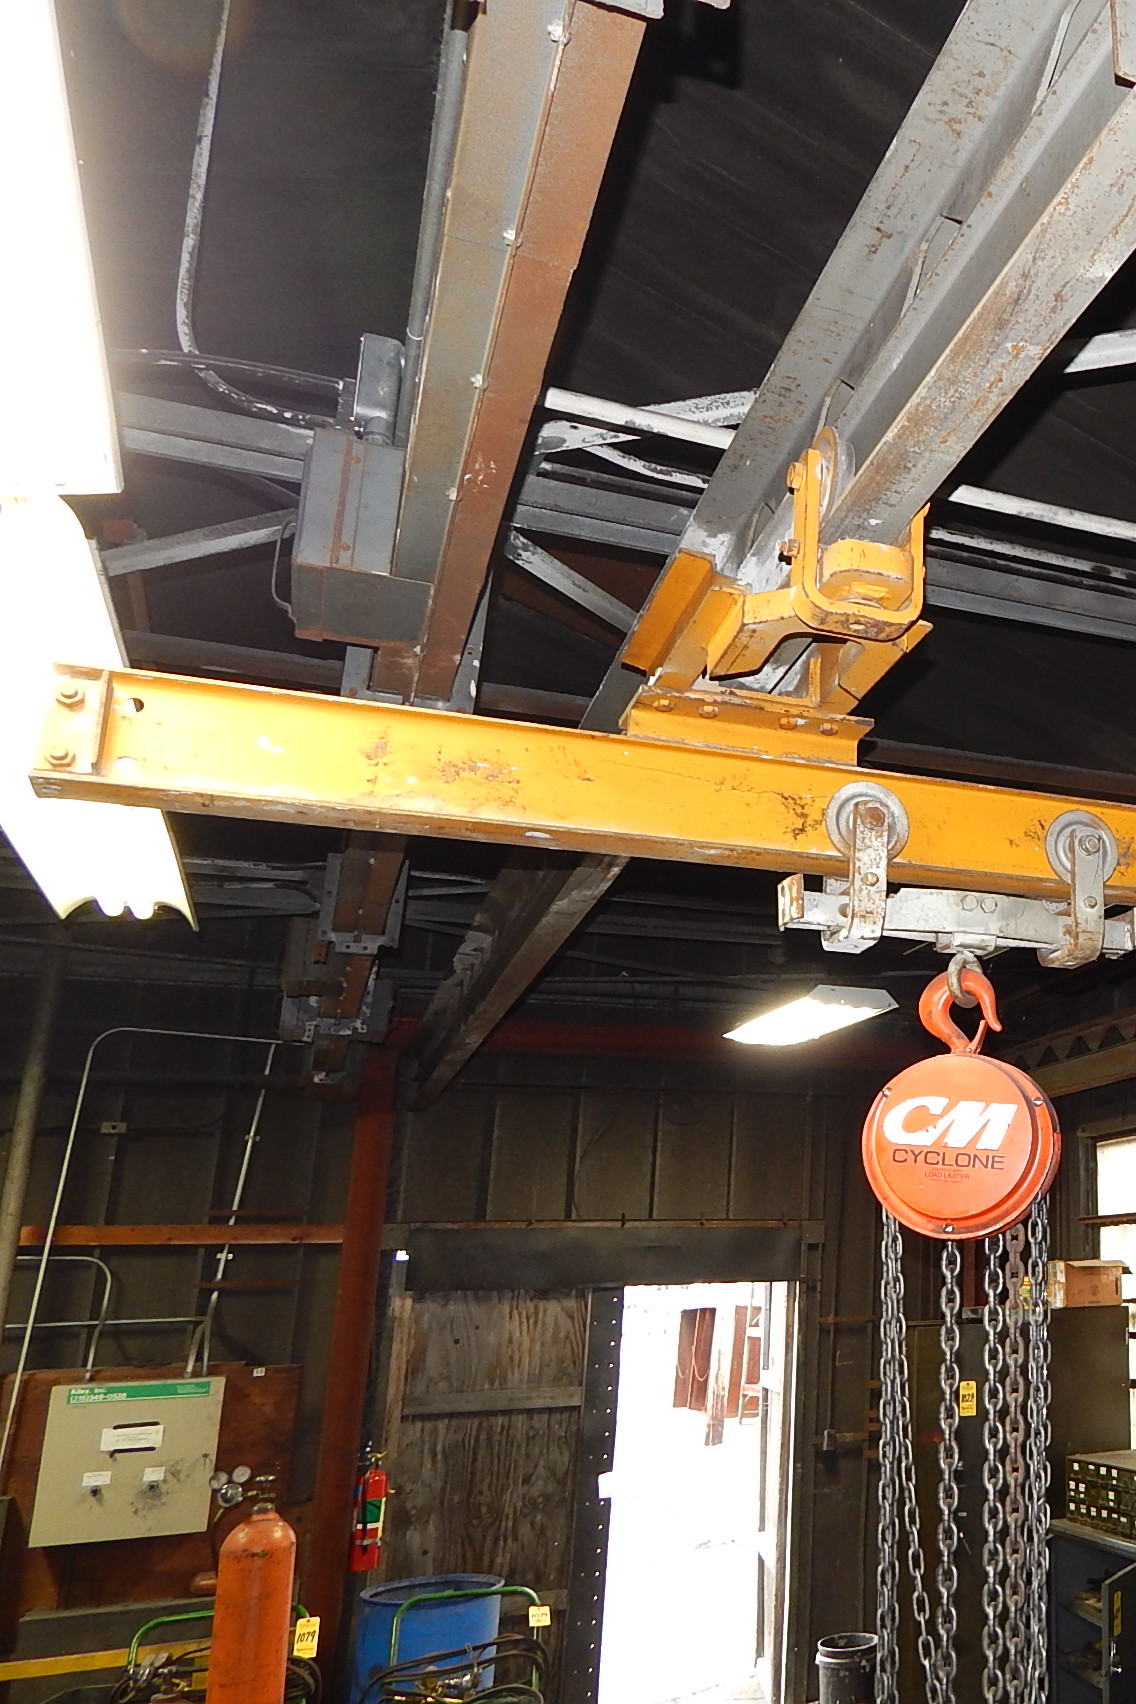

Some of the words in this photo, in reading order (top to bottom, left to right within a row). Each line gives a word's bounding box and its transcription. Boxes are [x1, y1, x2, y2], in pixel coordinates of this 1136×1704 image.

[882, 1095, 1019, 1151] CM
[892, 1148, 1006, 1170] CYCLONE
[924, 1170, 943, 1178] LOAD
[943, 1172, 970, 1180] LIMITER
[296, 1629, 317, 1645] 1079
